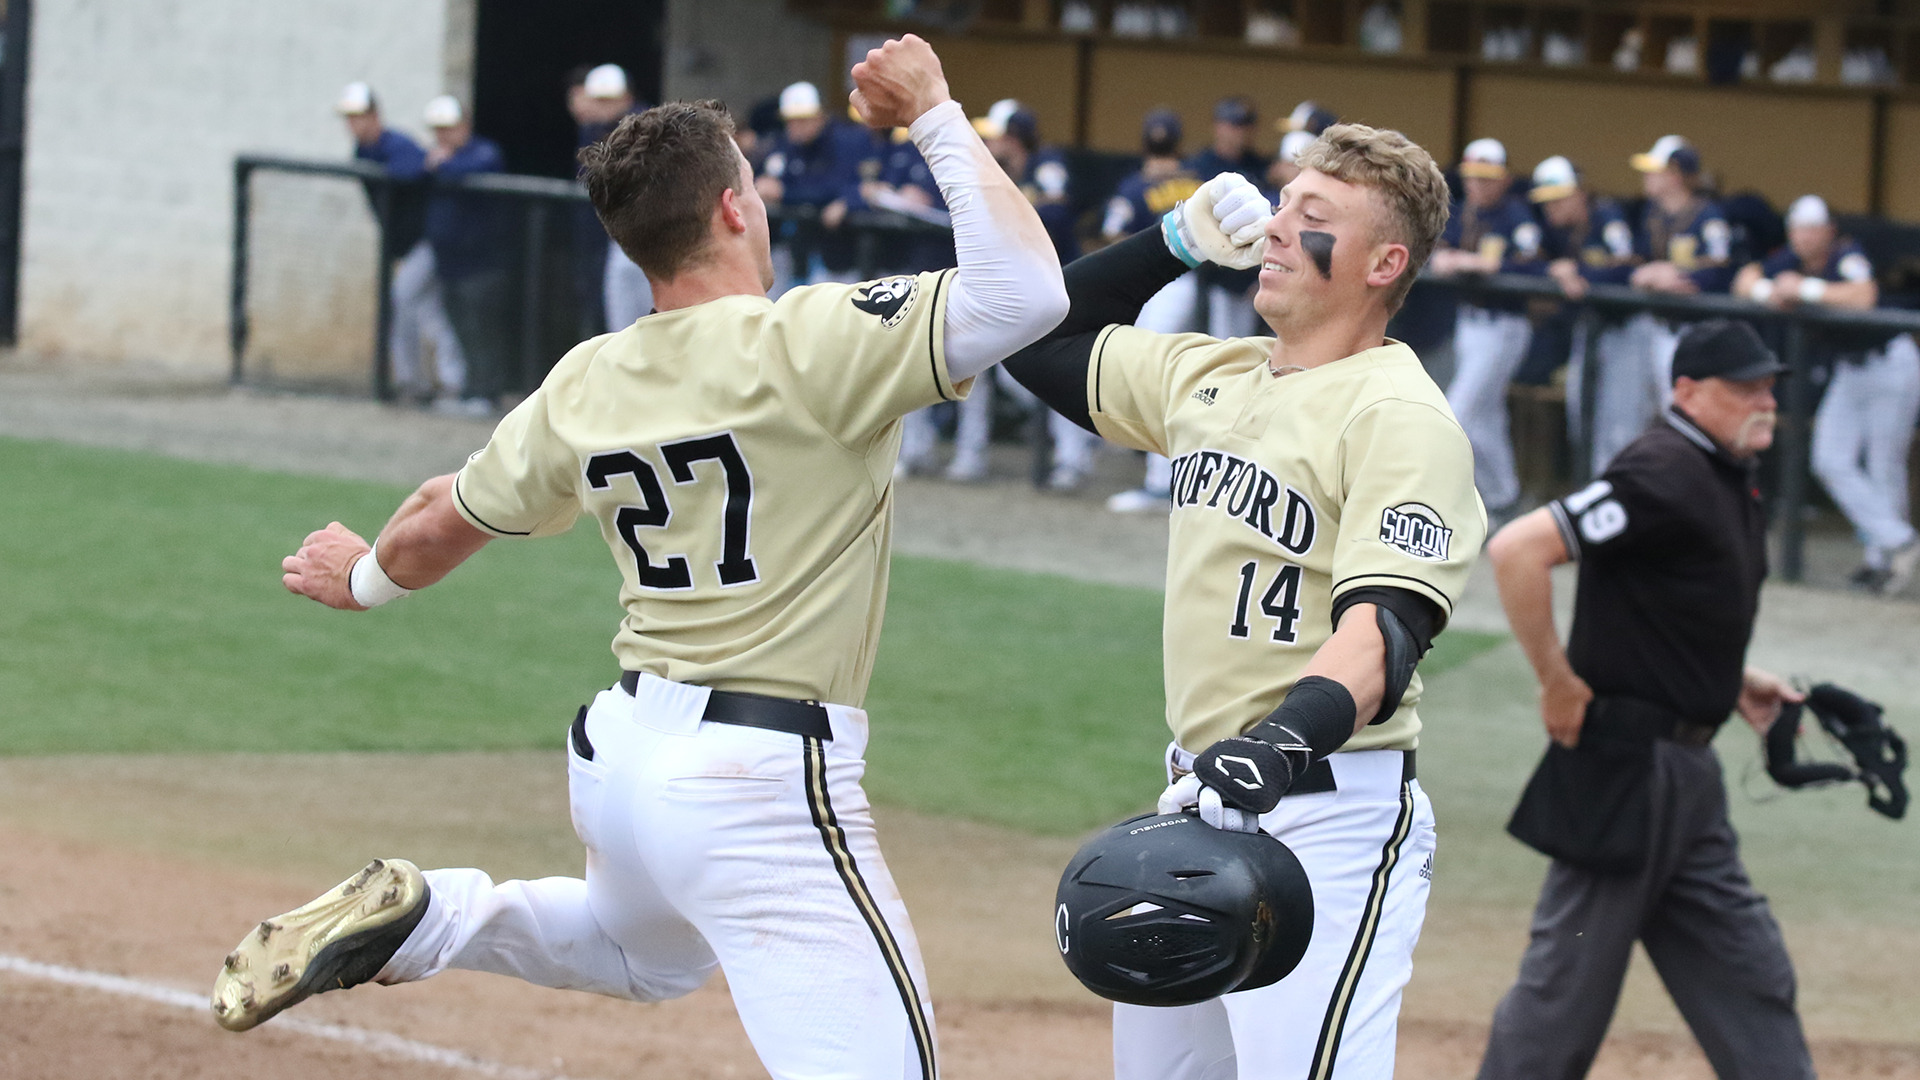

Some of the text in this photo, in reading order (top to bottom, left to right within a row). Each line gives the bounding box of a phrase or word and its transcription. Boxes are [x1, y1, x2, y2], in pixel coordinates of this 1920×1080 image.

[584, 429, 761, 591] 27
[1564, 480, 1628, 543] 19
[1229, 560, 1303, 645] 14
[1129, 818, 1188, 835] EVOSHIELD
